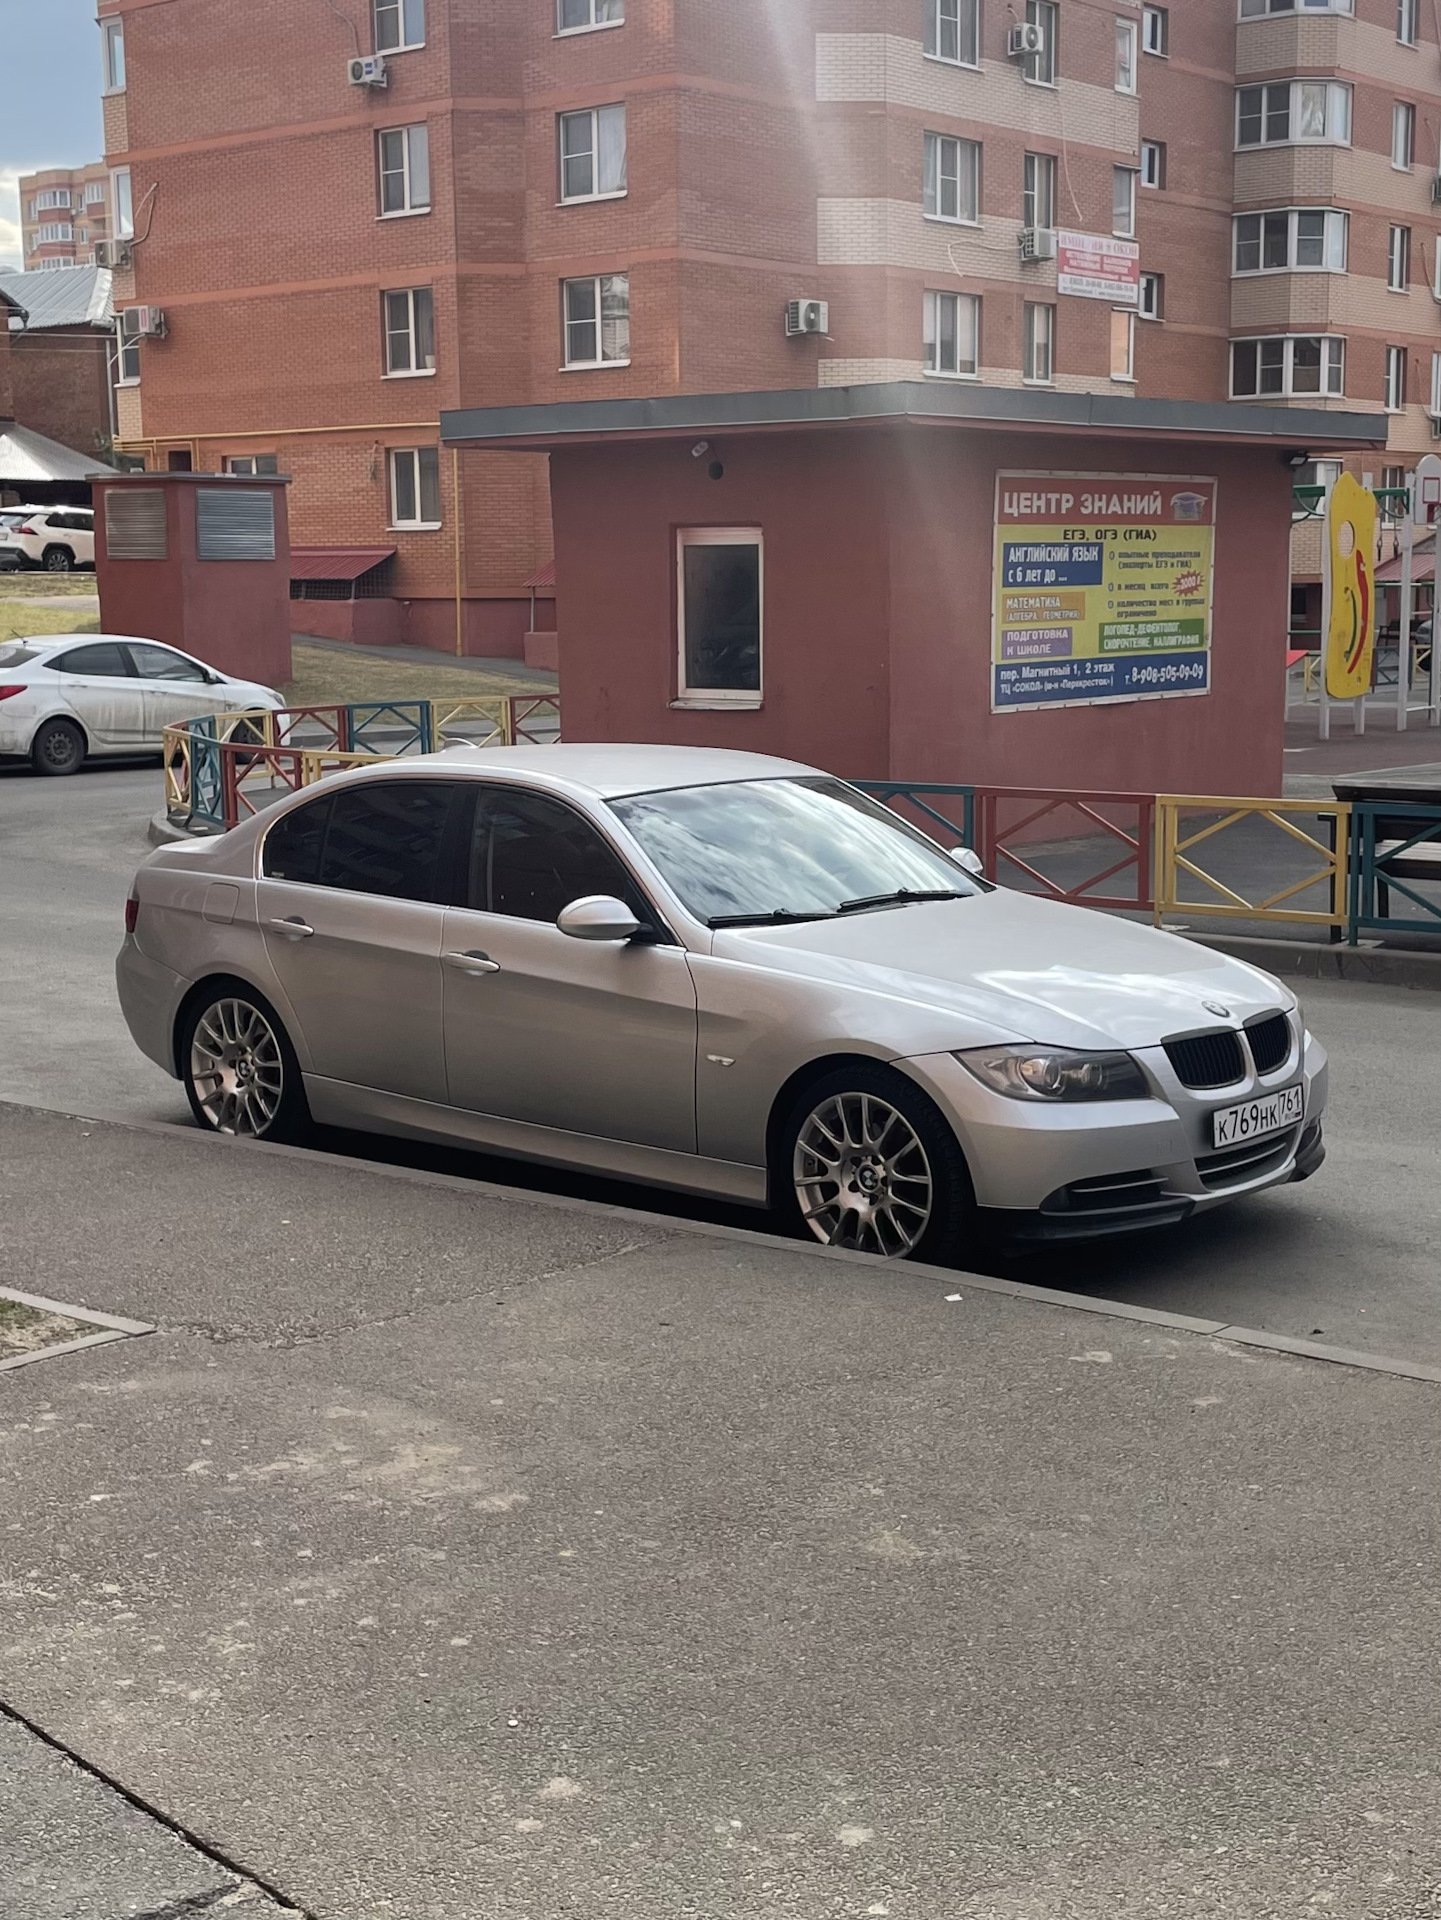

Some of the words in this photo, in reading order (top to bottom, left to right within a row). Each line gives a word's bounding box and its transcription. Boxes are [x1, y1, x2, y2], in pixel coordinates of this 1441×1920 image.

[1004, 492, 1074, 517] ЦЕНТР
[1080, 490, 1162, 515] ЗНАНИЙ
[1063, 530, 1089, 541] ЕГЭ,
[1095, 529, 1118, 540] ОГЭ
[1123, 529, 1157, 541] (ГИА)
[1008, 544, 1069, 562] АНГЛИЙСКИЙ
[1072, 546, 1099, 562] ЯЗЫК
[1156, 560, 1168, 568] ЕГЭ
[1008, 570, 1014, 582] с
[1016, 567, 1022, 582] 6
[1025, 569, 1042, 582] лет
[1044, 569, 1056, 584] до
[1006, 596, 1060, 609] МАТЕМАТИКА
[1006, 630, 1068, 642] ПОДГОТОВКА
[1006, 646, 1014, 656] К
[1017, 644, 1052, 655] ШКОЛЕ
[1000, 670, 1020, 682] пер.
[1022, 664, 1070, 678] Магнитный
[1073, 664, 1080, 676] 1,
[1086, 662, 1092, 674] 2
[1094, 662, 1115, 673] этаж
[1132, 663, 1204, 684] 8-908-505-09-09
[1000, 684, 1010, 695] ТЦ
[1280, 1088, 1300, 1114] 761
